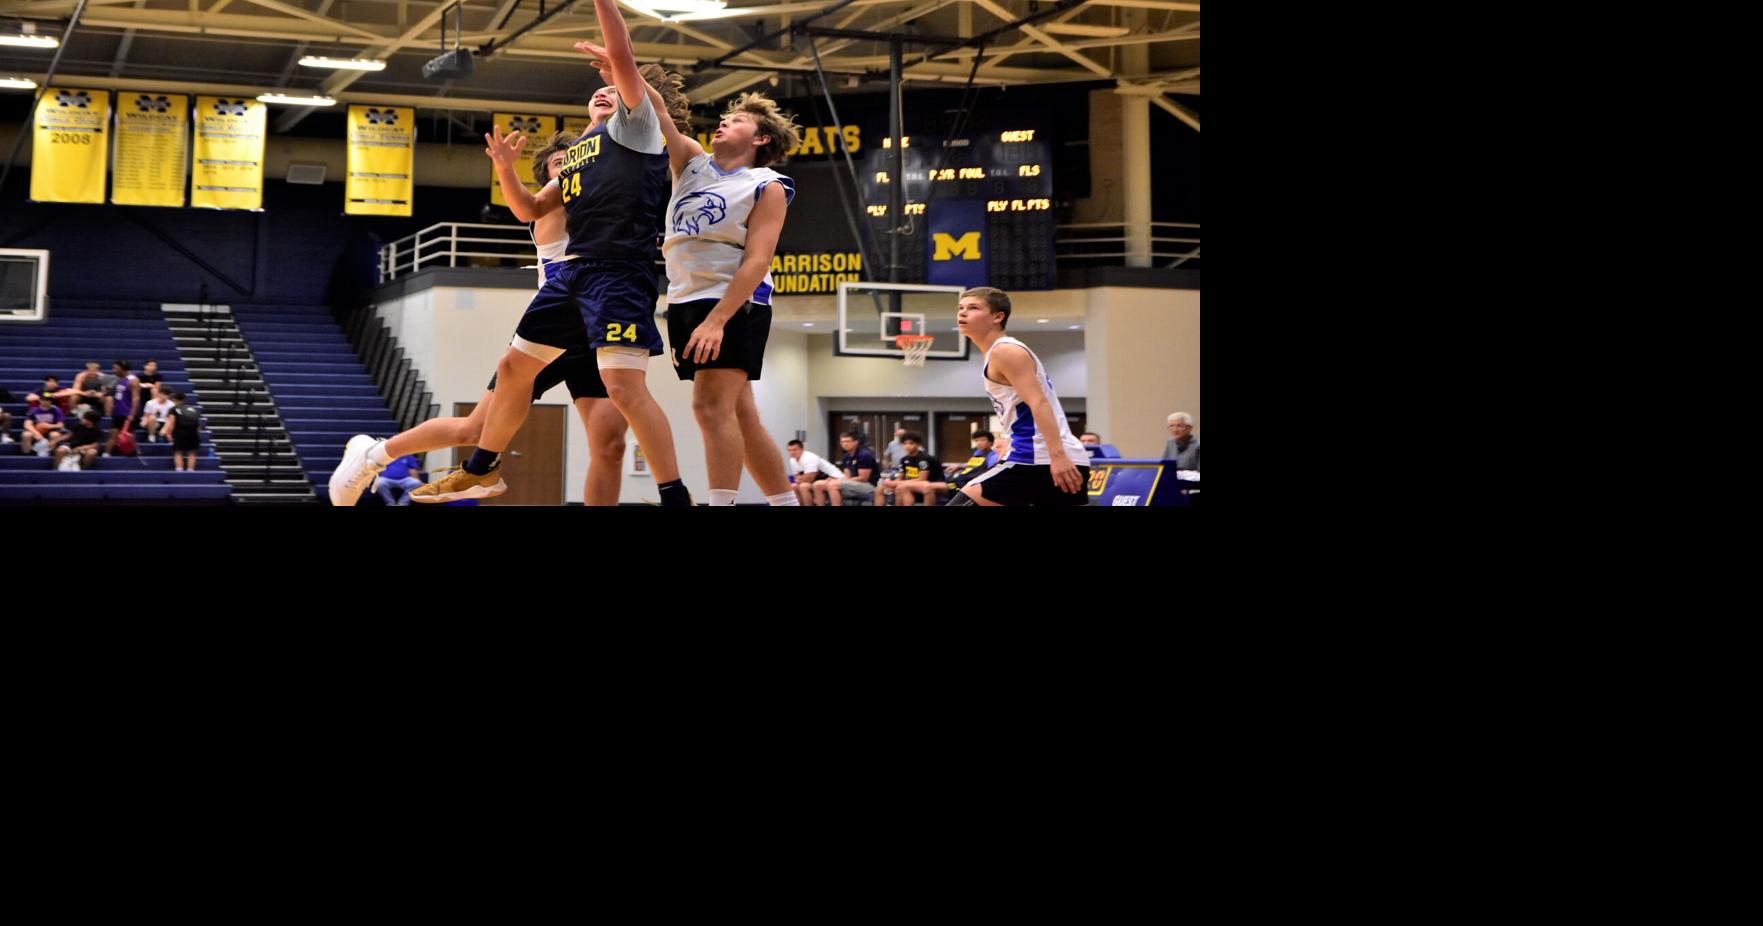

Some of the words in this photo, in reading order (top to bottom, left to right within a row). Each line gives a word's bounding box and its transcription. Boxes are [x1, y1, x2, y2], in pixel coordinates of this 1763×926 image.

[50, 132, 91, 144] 2008
[1001, 130, 1035, 143] GUEST
[561, 139, 596, 168] ARION
[959, 167, 985, 179] FOUL
[1018, 164, 1041, 177] FLS
[562, 172, 582, 204] 24
[932, 231, 983, 261] M
[770, 253, 862, 273] ARRISON
[606, 323, 637, 343] 24
